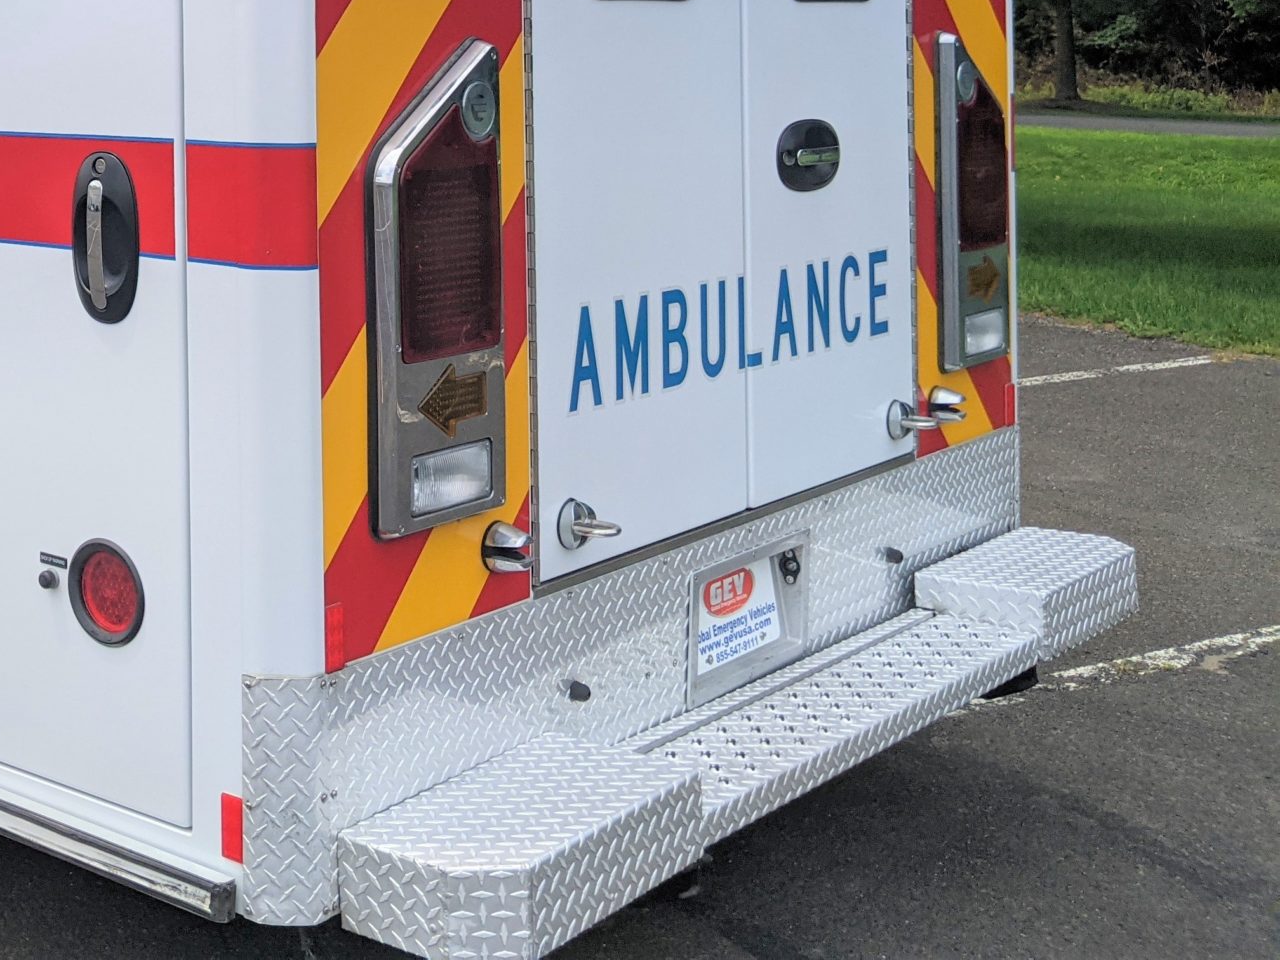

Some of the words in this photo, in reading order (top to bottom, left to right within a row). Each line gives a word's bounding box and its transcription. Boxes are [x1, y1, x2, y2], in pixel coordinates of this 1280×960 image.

[569, 249, 889, 413] AMBULANCE
[709, 571, 745, 606] GEV
[698, 627, 711, 644] obal
[713, 615, 748, 637] Emergency
[748, 601, 776, 621] Vehicles
[699, 616, 772, 656] www.gevusa.com
[715, 635, 759, 663] 855-547-9111
